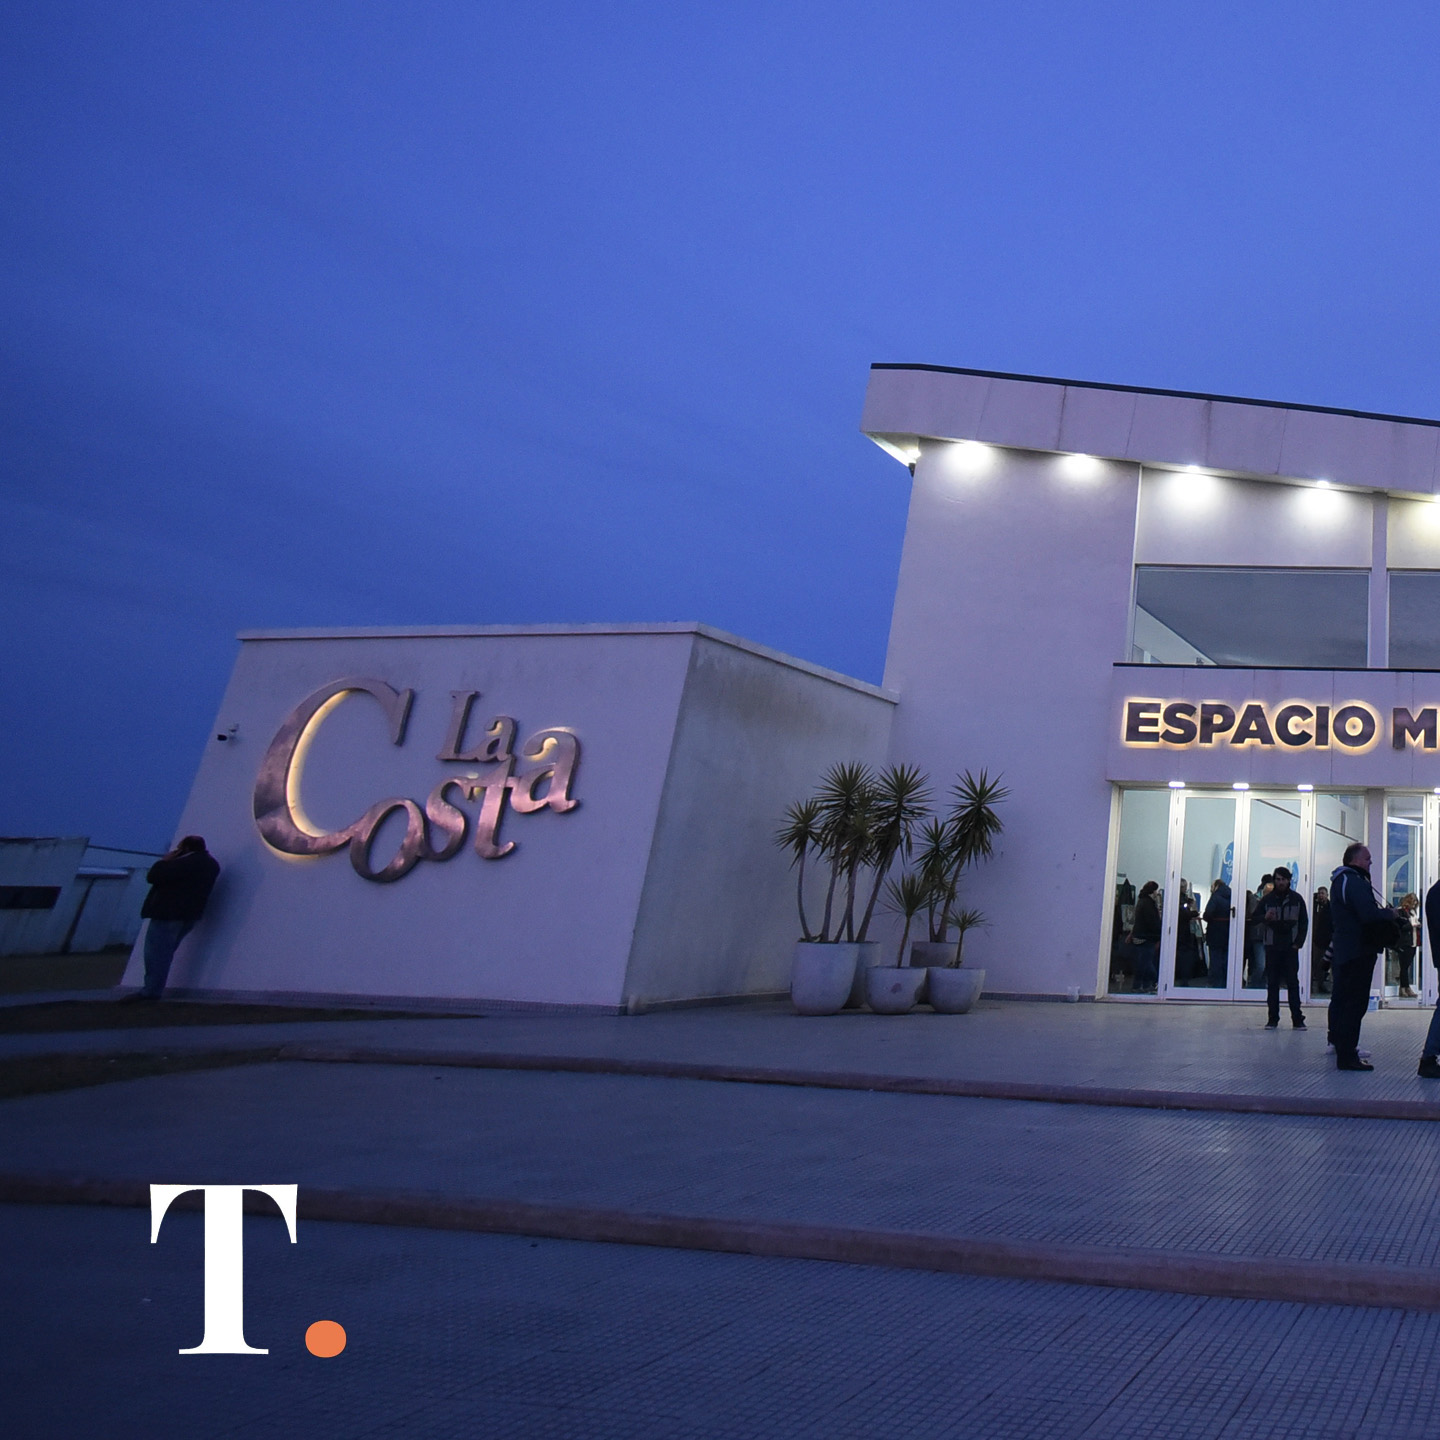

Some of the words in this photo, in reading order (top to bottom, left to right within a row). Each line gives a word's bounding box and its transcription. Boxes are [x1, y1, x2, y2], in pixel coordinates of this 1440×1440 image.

[436, 690, 519, 763] La
[1125, 701, 1376, 747] ESPACIO
[253, 677, 582, 882] Costa
